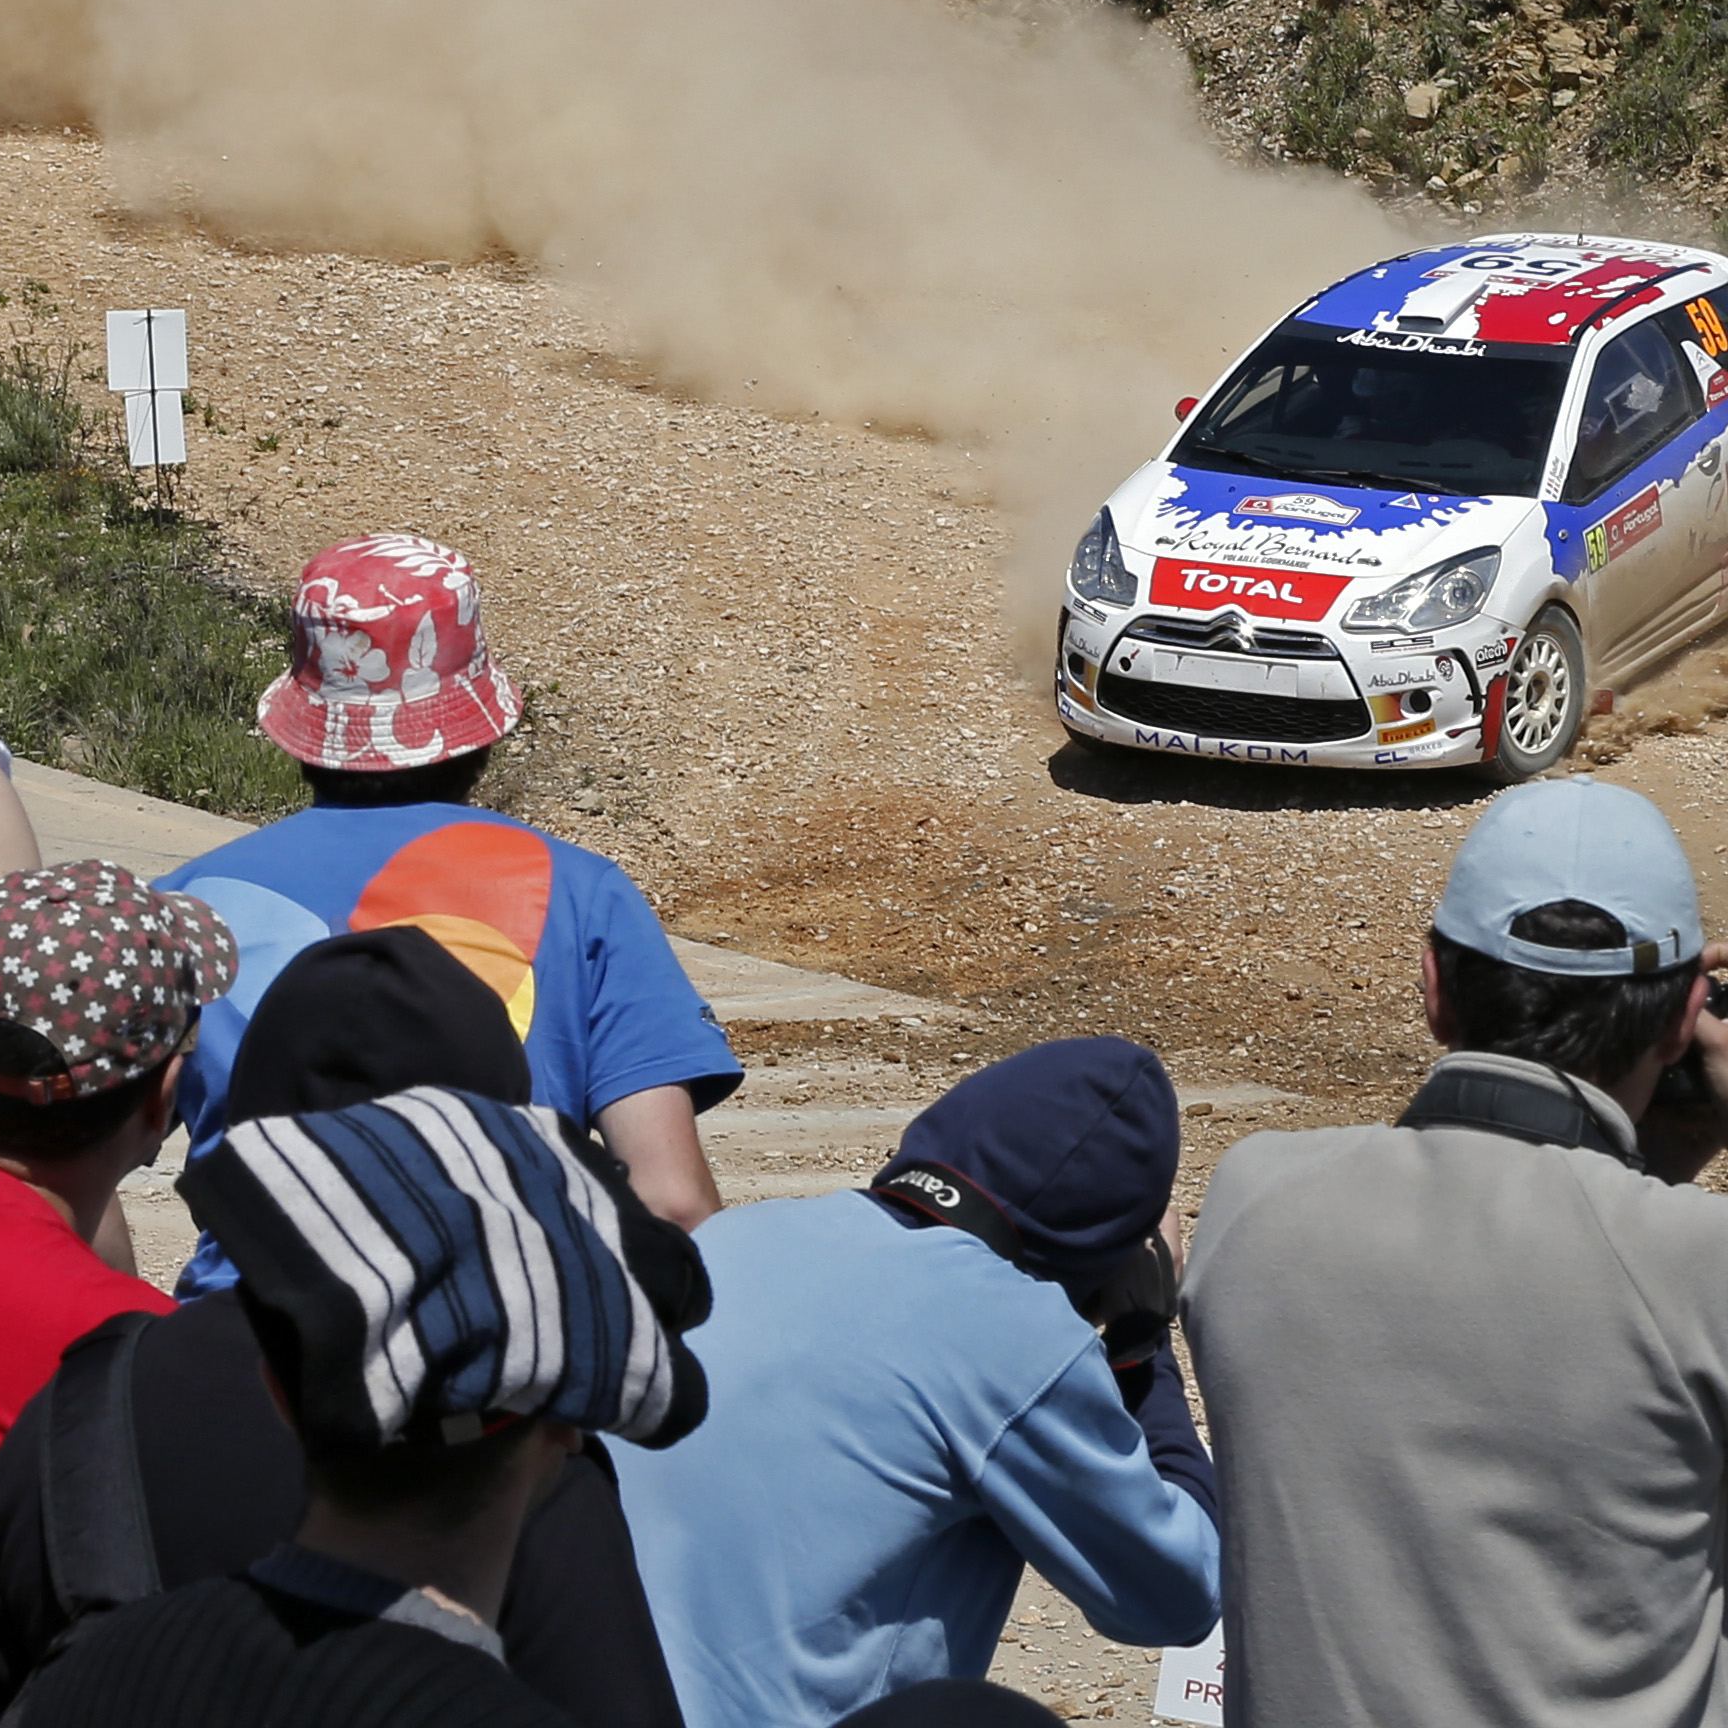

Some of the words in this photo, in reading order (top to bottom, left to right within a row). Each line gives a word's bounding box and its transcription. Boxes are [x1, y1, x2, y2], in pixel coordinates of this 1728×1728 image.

[1685, 296, 1728, 358] 59
[1274, 503, 1348, 520] Portugal
[1292, 495, 1316, 506] 59
[1623, 500, 1660, 535] Portugal
[1171, 530, 1250, 558] Royal
[1253, 532, 1362, 566] Bernard
[1222, 553, 1259, 565] VOLAILLE
[1586, 526, 1608, 573] 59
[1180, 568, 1304, 604] TOTAL
[1381, 721, 1433, 744] PIRELLI
[1375, 750, 1409, 765] CL
